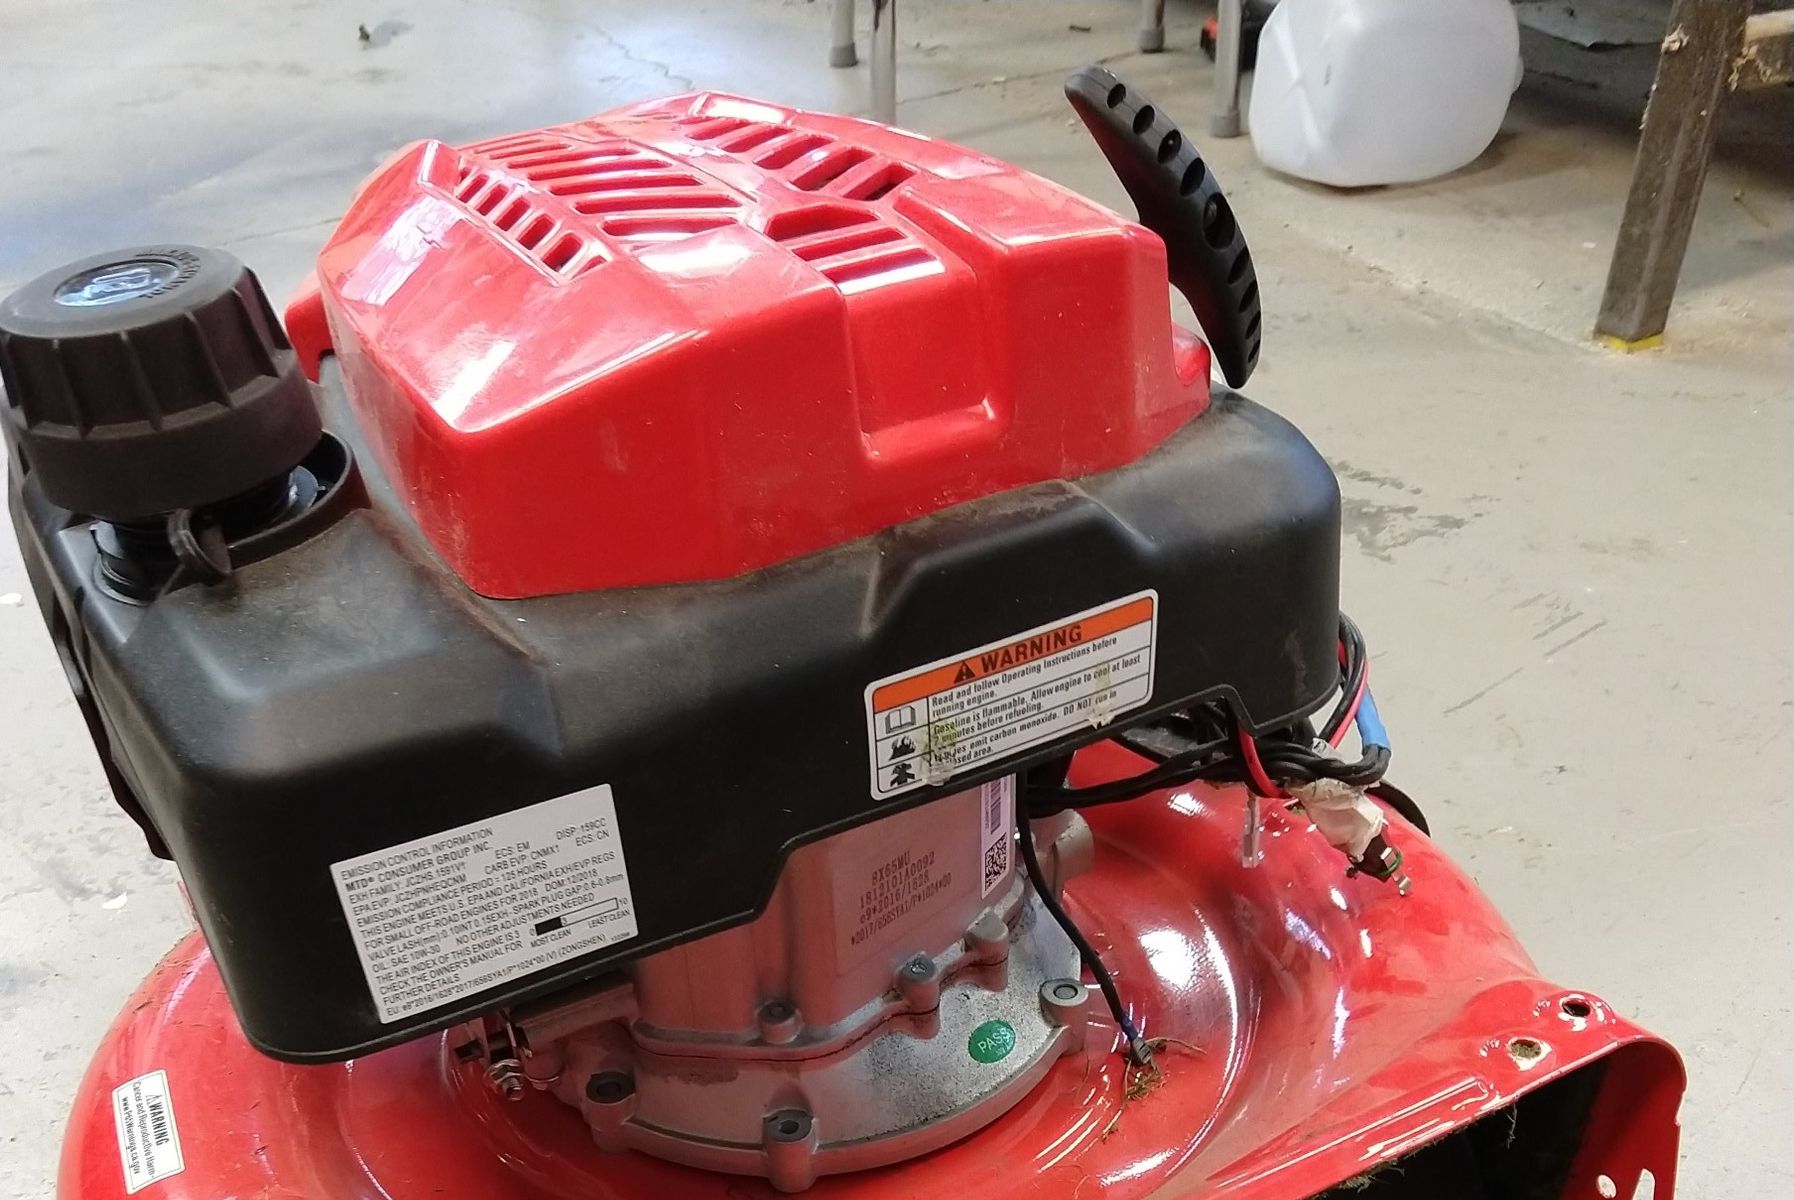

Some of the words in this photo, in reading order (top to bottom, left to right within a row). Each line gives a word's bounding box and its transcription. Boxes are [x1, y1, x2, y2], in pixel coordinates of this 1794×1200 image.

[980, 622, 1082, 674] WARNING
[931, 690, 953, 708] Read
[955, 684, 971, 700] and
[973, 675, 999, 694] follow
[1001, 660, 1041, 685] Operating
[1043, 644, 1090, 669] Instructions
[1092, 634, 1117, 653] before
[932, 699, 964, 719] running
[966, 687, 997, 708] engine.
[933, 712, 970, 735] Gasoline
[972, 709, 980, 722] is
[982, 692, 1027, 719] flammable.
[1030, 683, 1053, 701] Allow
[1052, 675, 1079, 696] engine
[1083, 670, 1091, 683] to
[1093, 662, 1110, 679] cool
[1111, 660, 1120, 673] at
[1121, 652, 1140, 669] least
[969, 733, 987, 749] emit
[989, 723, 1016, 742] carbon
[1019, 708, 1059, 732] monoxide.
[1063, 703, 1074, 716] DO
[1076, 696, 1091, 711] NOT
[976, 713, 1003, 732] before
[1004, 698, 1043, 723] refueling.
[973, 743, 993, 758] area.
[515, 839, 531, 853] EM
[595, 827, 610, 840] CN
[340, 858, 387, 880] EMISSION
[386, 844, 432, 866] CONTROL
[431, 826, 493, 853] INFORMATION
[376, 856, 435, 883] CONSUMER
[434, 845, 472, 865] GROUP
[483, 858, 509, 875] CARB
[348, 890, 368, 904] EXH
[351, 901, 372, 916] EPA
[355, 905, 401, 928] EMISSION
[400, 886, 460, 914] COMPLIANCE
[459, 876, 494, 895] PERIOD
[499, 868, 516, 882] 125
[515, 858, 548, 877] HOURS
[359, 923, 382, 939] THIS
[381, 912, 417, 932] ENGINE
[416, 902, 448, 921] MEETS
[466, 890, 487, 905] EPA
[484, 885, 503, 900] AND
[502, 869, 554, 894] CALIFORNIA
[590, 849, 615, 866] REGS
[363, 935, 384, 951] FOR
[383, 926, 415, 944] SMALL
[413, 911, 460, 935] OFF-ROAD
[459, 899, 499, 920] ENGINES
[498, 892, 518, 907] FOR
[366, 944, 397, 962] VALVE
[512, 897, 540, 915] SPARK
[540, 890, 564, 906] PLUG
[389, 952, 409, 967] SAE
[409, 942, 441, 961] 10W-30
[454, 932, 470, 946] NO
[469, 922, 500, 941] OTHER
[499, 902, 560, 931] ADJUSTMENTS
[559, 891, 595, 911] NEEDED
[587, 914, 610, 929] LEAST
[608, 907, 630, 922] CLEAN
[529, 934, 551, 949] MOST
[548, 926, 572, 942] CLEAN
[556, 931, 607, 957] (ZONGSHEN)
[375, 971, 395, 986] THE
[393, 966, 411, 979] AIR
[409, 956, 439, 974] INDEX
[437, 952, 451, 965] OF
[450, 945, 472, 960] THIS
[470, 934, 504, 954] ENGINE
[504, 931, 514, 942] IS
[378, 976, 411, 996] CHECK
[410, 971, 429, 985] THE
[428, 957, 469, 979] OWNER'S
[468, 945, 505, 966] MANUAL
[504, 939, 523, 954] FOR
[381, 984, 426, 1006] FURTHER
[424, 972, 461, 992] DETAILS
[132, 1081, 143, 1102] Cancer
[136, 1102, 145, 1115] and
[137, 1113, 154, 1157] Reproductive
[149, 1102, 170, 1147] WARNING
